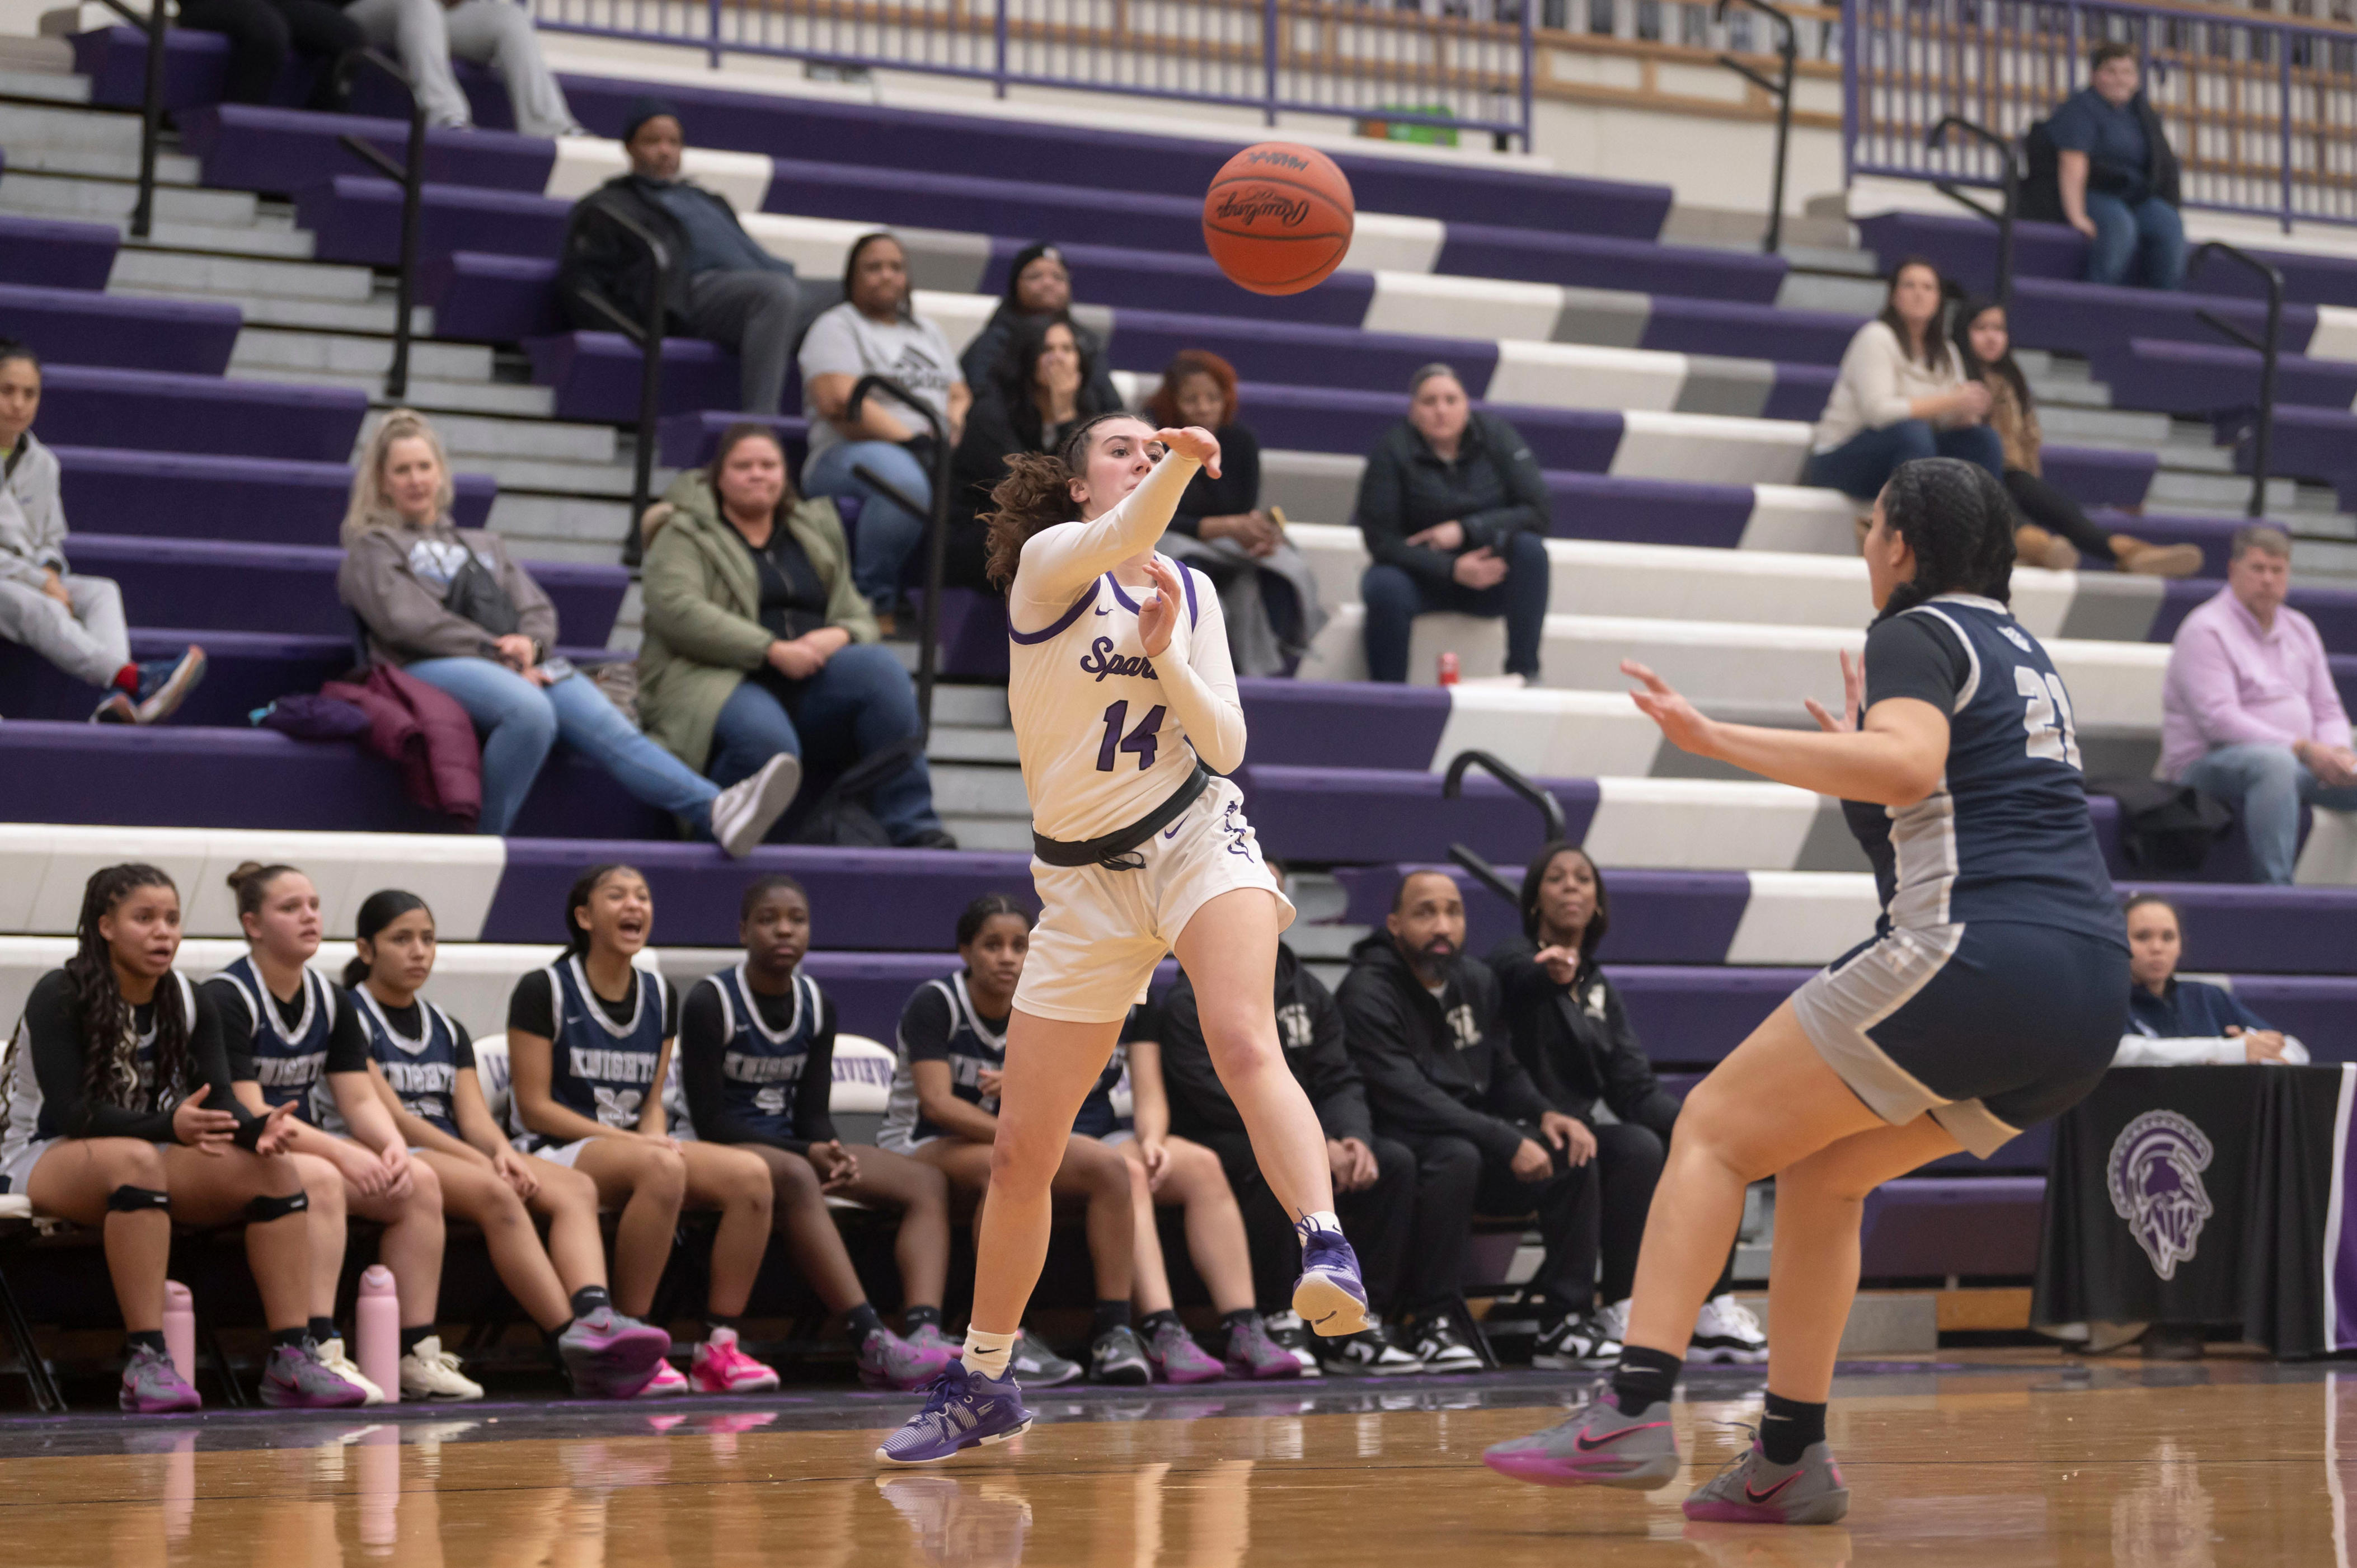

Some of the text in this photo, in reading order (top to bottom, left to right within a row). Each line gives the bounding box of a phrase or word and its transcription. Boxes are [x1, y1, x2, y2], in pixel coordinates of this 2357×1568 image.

[1217, 190, 1310, 227] Rawlings
[1080, 636, 1159, 682] Spar
[1096, 699, 1167, 772] 14
[2013, 665, 2083, 772] 21
